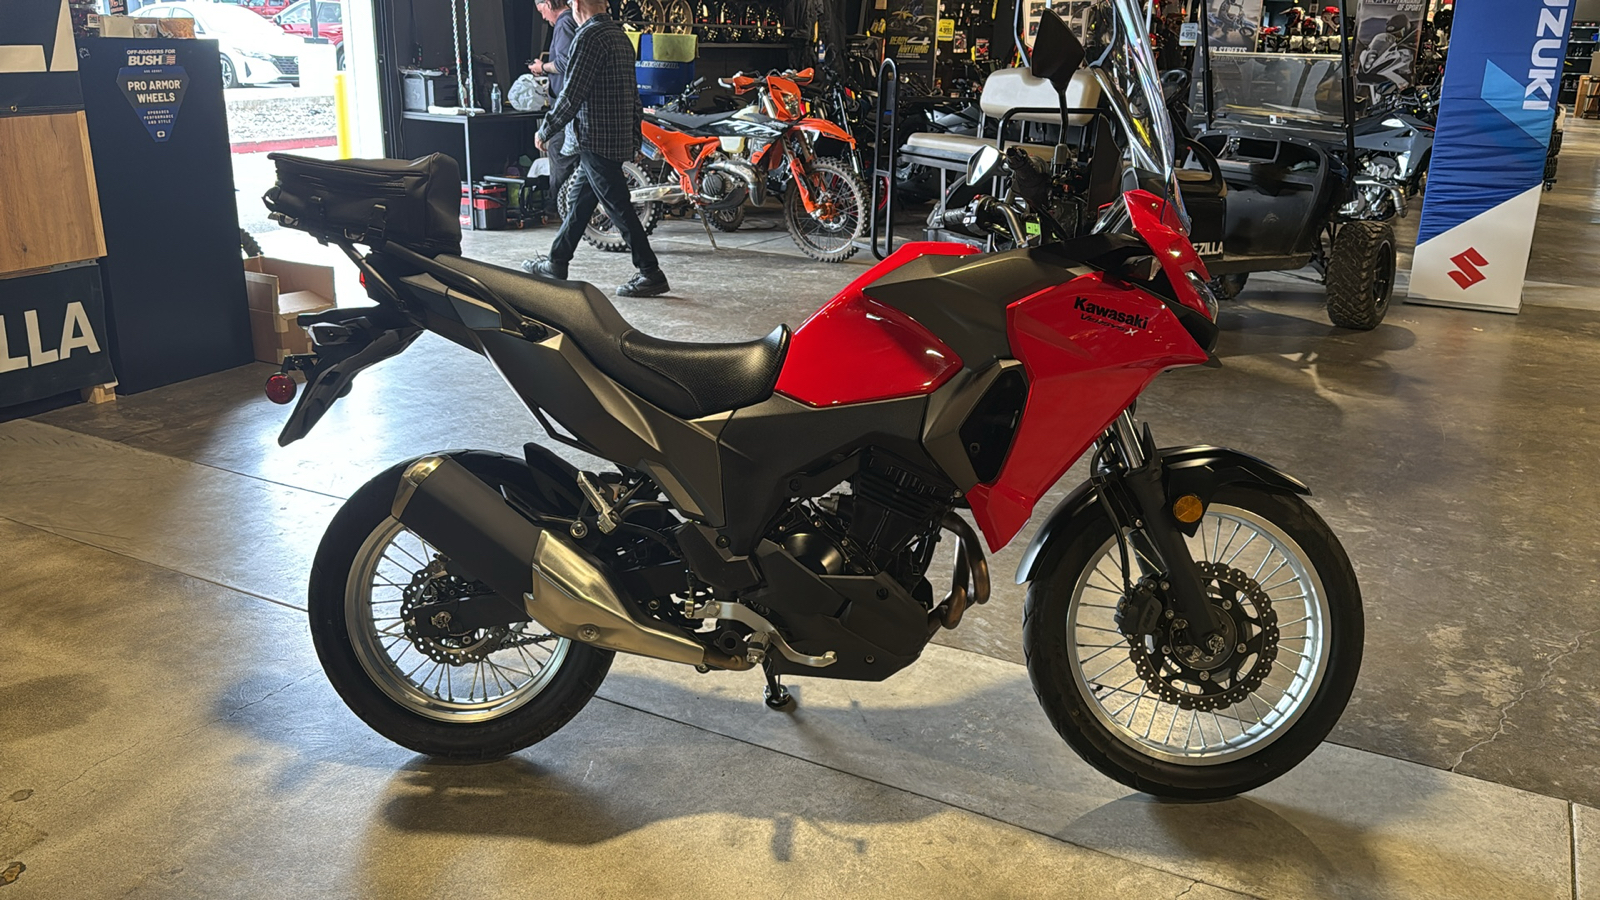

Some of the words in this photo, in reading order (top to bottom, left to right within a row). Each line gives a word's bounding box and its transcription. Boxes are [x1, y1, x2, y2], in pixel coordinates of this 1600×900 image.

[898, 44, 930, 54] ANYTHING
[1522, 0, 1569, 110] ZUKI
[128, 55, 162, 66] BUSH
[127, 80, 147, 91] PRO
[149, 79, 181, 91] ARMOR
[136, 92, 176, 104] WHEELS
[1074, 296, 1149, 330] Kawasaki
